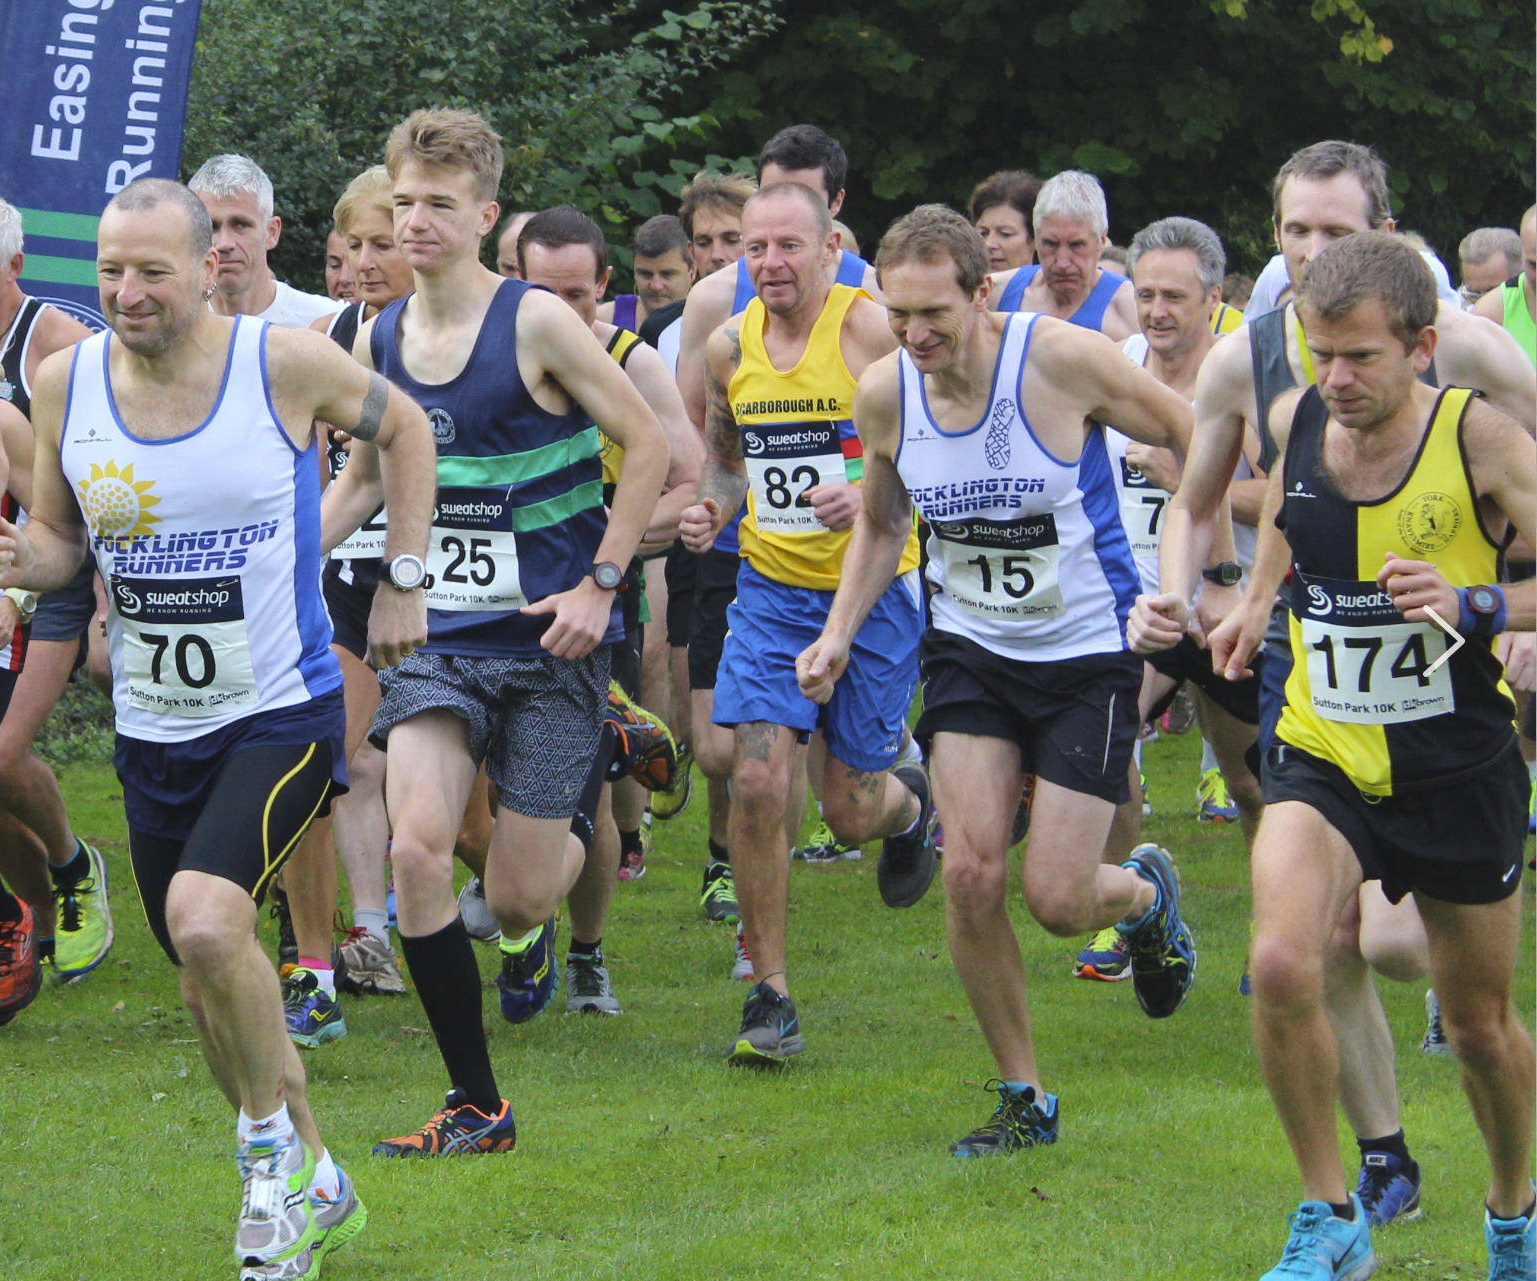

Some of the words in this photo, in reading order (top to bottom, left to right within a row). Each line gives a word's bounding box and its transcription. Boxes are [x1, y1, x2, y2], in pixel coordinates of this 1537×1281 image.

[105, 0, 187, 194] Runnin
[735, 399, 814, 416] SCARBOROUGH
[817, 398, 841, 412] A.C.
[767, 430, 830, 446] sweatshop
[764, 465, 820, 509] 82
[441, 501, 503, 519] sweatshop
[923, 495, 1022, 519] RUNNERS
[778, 517, 795, 525] Park
[94, 519, 280, 555] POCKLINGTON
[973, 524, 1045, 539] sweatshop
[356, 541, 374, 549] Park
[113, 548, 249, 574] RUNNERS
[441, 536, 496, 587] 25
[968, 554, 1035, 599] 15
[145, 589, 230, 608] sweatshop
[424, 590, 448, 601] Sutton
[450, 593, 467, 603] Park
[469, 596, 485, 604] 10K
[1335, 591, 1393, 608] sweats
[979, 601, 999, 612] Park
[1001, 606, 1019, 614] 10K
[139, 632, 216, 689] 70
[1313, 633, 1436, 693] 174
[130, 686, 155, 703] Sutton
[157, 695, 181, 707] Park
[183, 699, 205, 707] 10K
[1313, 697, 1343, 711] Sutton
[1345, 702, 1371, 713] Park
[1374, 704, 1397, 713] 10K
